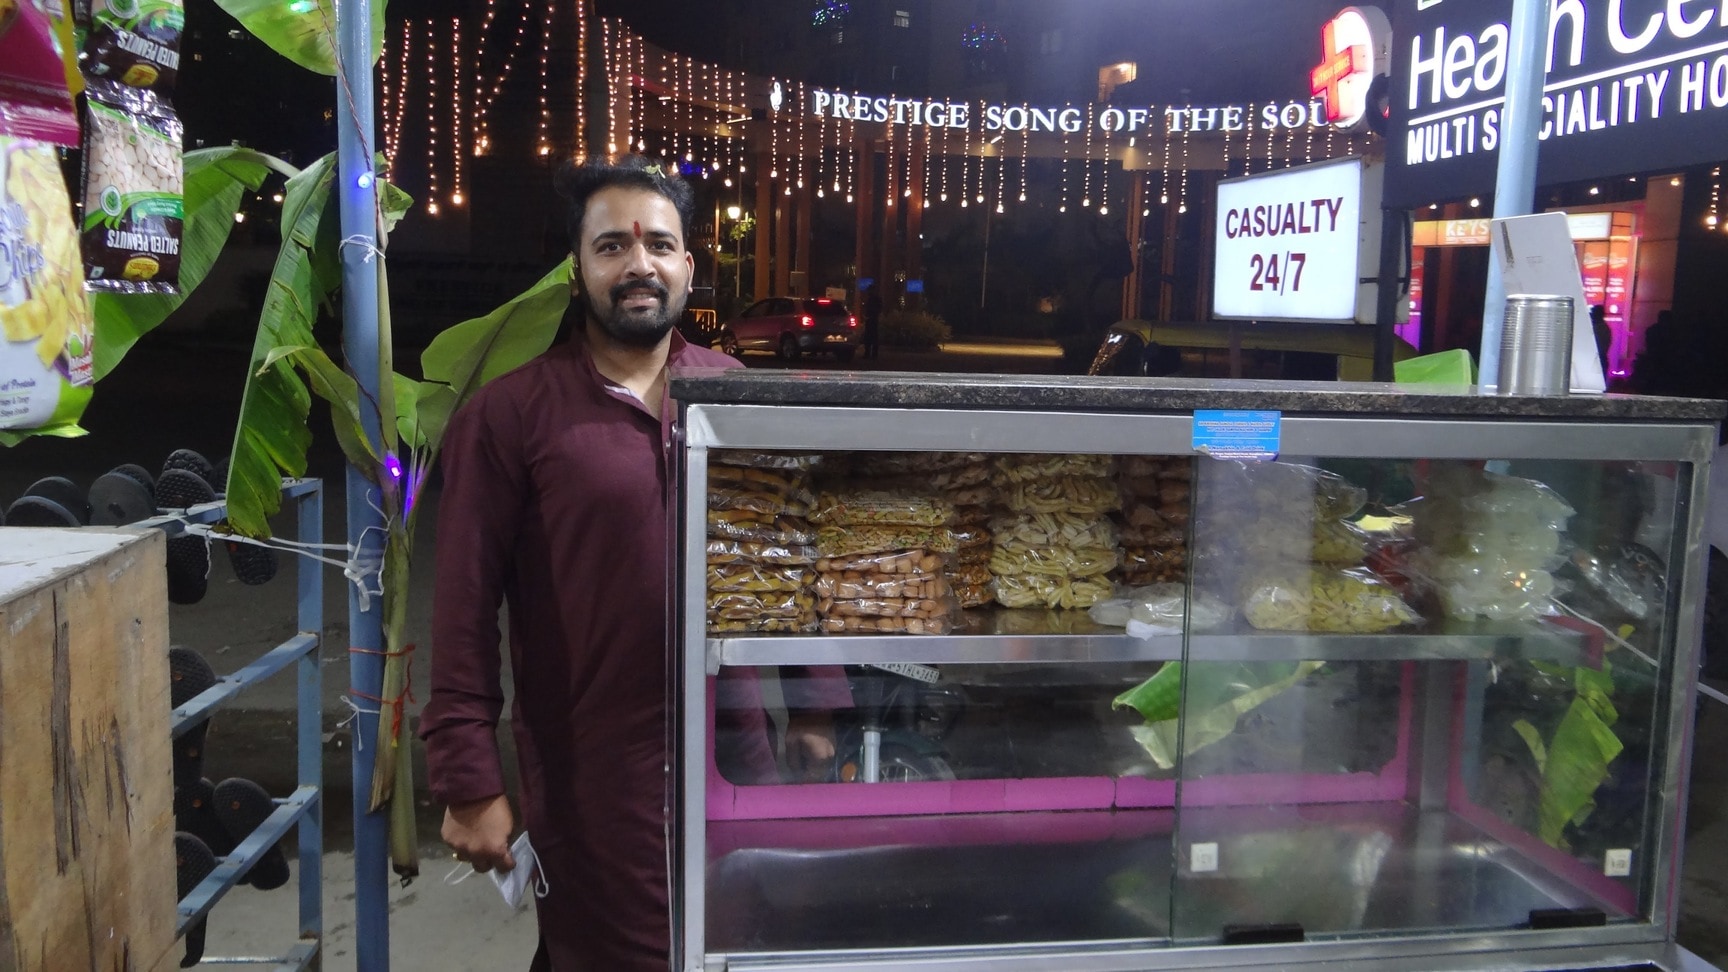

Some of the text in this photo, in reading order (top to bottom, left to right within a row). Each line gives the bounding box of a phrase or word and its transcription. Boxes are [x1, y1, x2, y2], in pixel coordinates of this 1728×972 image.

[1408, 0, 1585, 109] Heah
[813, 90, 1330, 133] PRESTIGE SONG OF THE SOU
[1407, 115, 1475, 165] MULTI
[1482, 69, 1670, 151] SCIALITY
[1225, 197, 1344, 239] CASUALTY
[1446, 220, 1488, 237] KEYS
[106, 229, 179, 256] SALTED PEANUTS
[1250, 251, 1306, 296] 24/7
